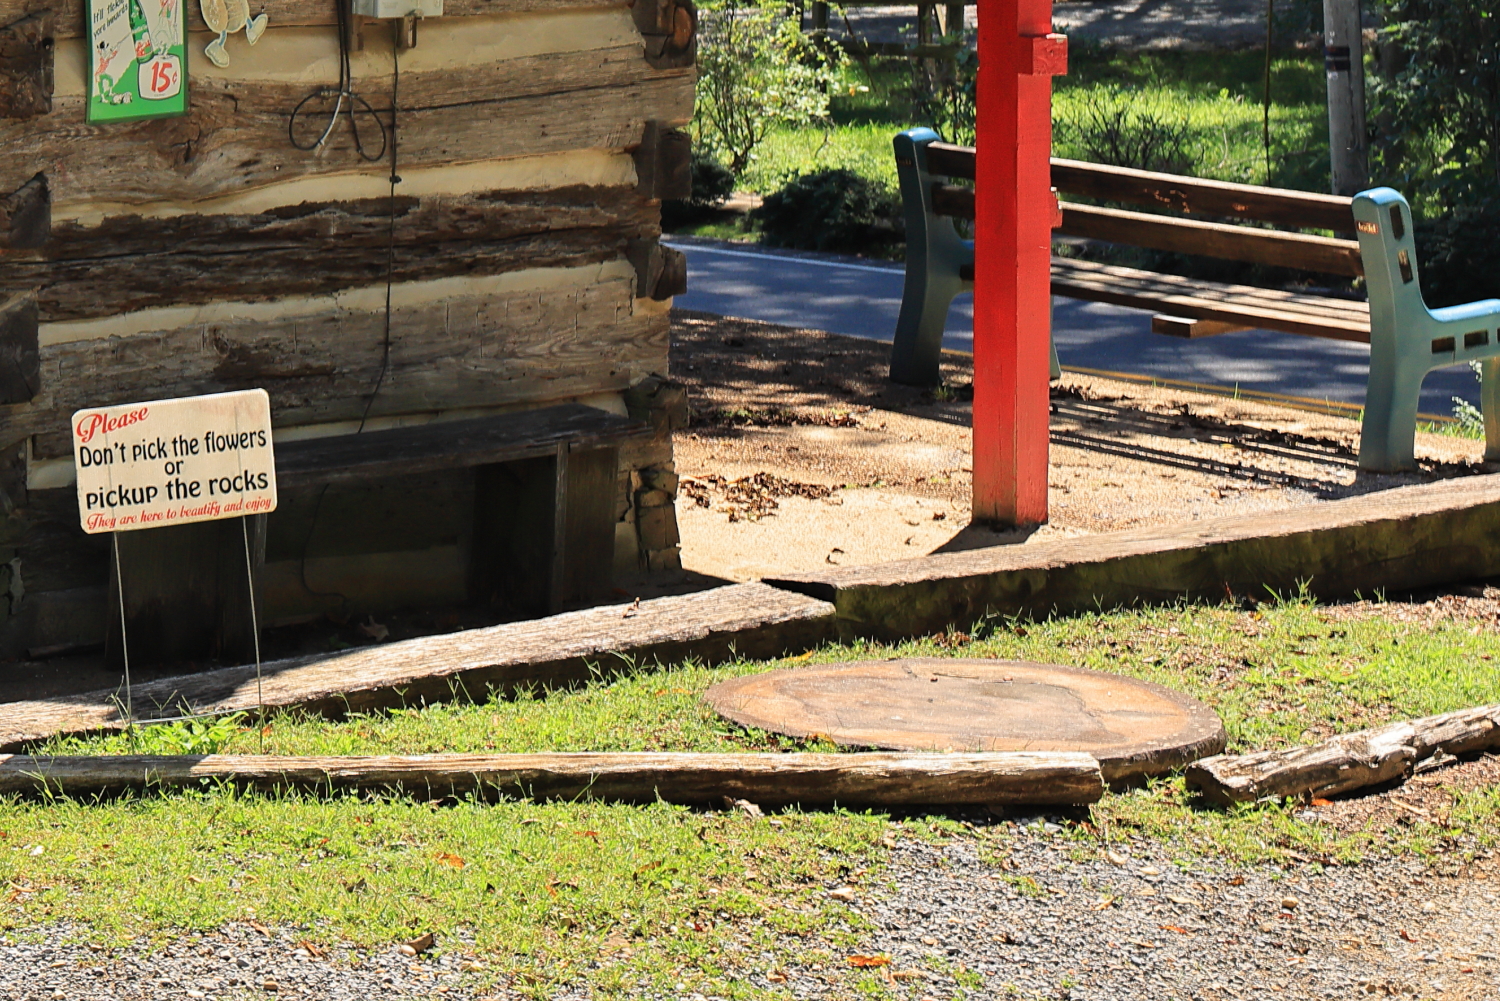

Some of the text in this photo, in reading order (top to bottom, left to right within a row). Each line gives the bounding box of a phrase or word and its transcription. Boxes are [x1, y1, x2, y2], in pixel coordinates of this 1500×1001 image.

[76, 406, 150, 444] Please
[79, 429, 268, 468] Don't pick the flowers
[164, 460, 185, 476] or
[86, 469, 269, 510] pickup the rocks
[87, 495, 272, 530] They are here to beautify and enjoy
